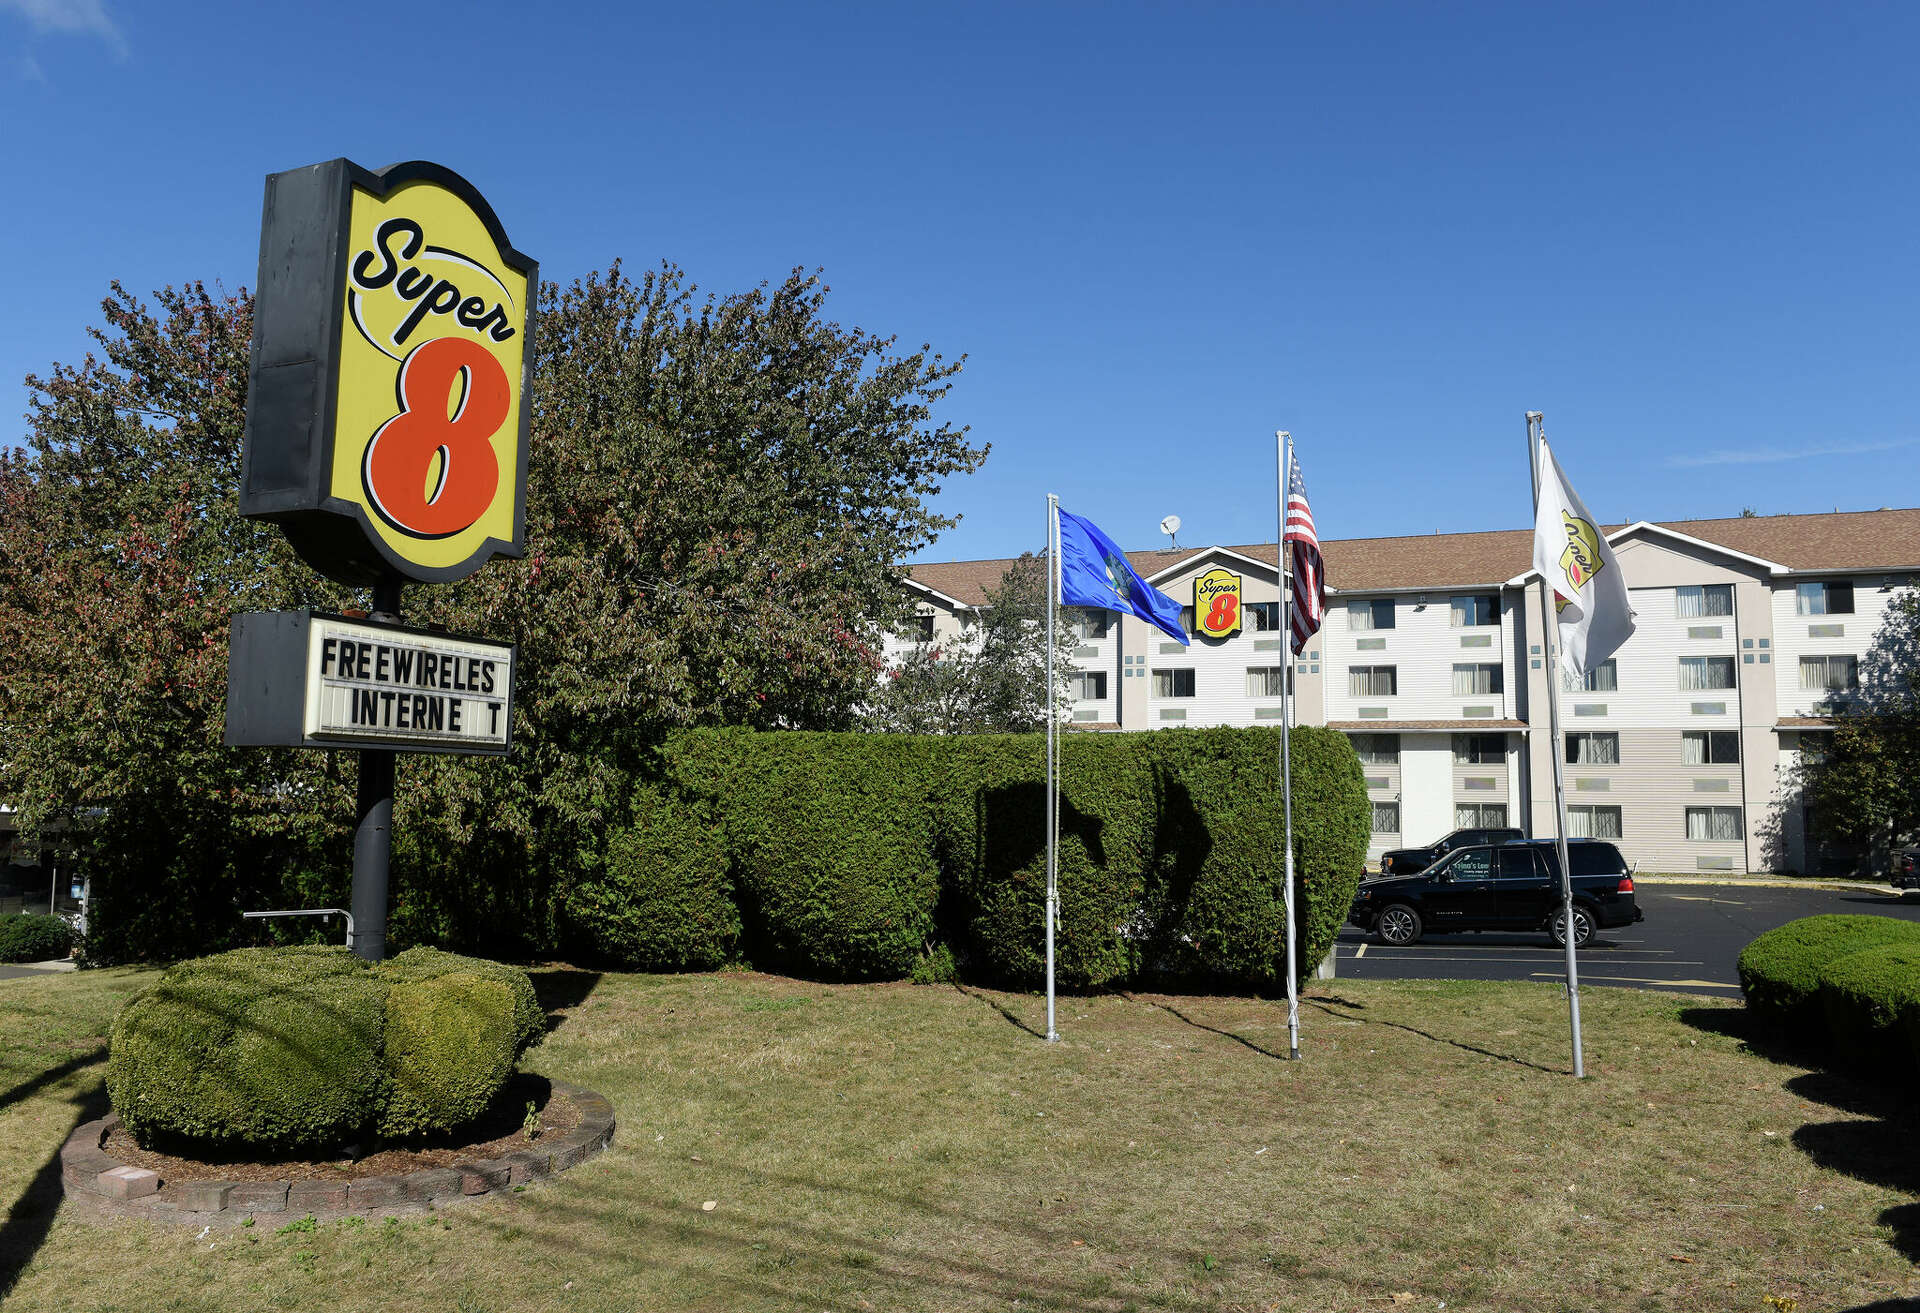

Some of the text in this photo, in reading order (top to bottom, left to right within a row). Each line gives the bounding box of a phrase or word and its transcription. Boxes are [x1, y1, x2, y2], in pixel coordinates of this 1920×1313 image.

[350, 217, 516, 346] Super
[361, 337, 511, 540] 8
[1199, 578, 1238, 601] Super
[1204, 593, 1239, 632] 8
